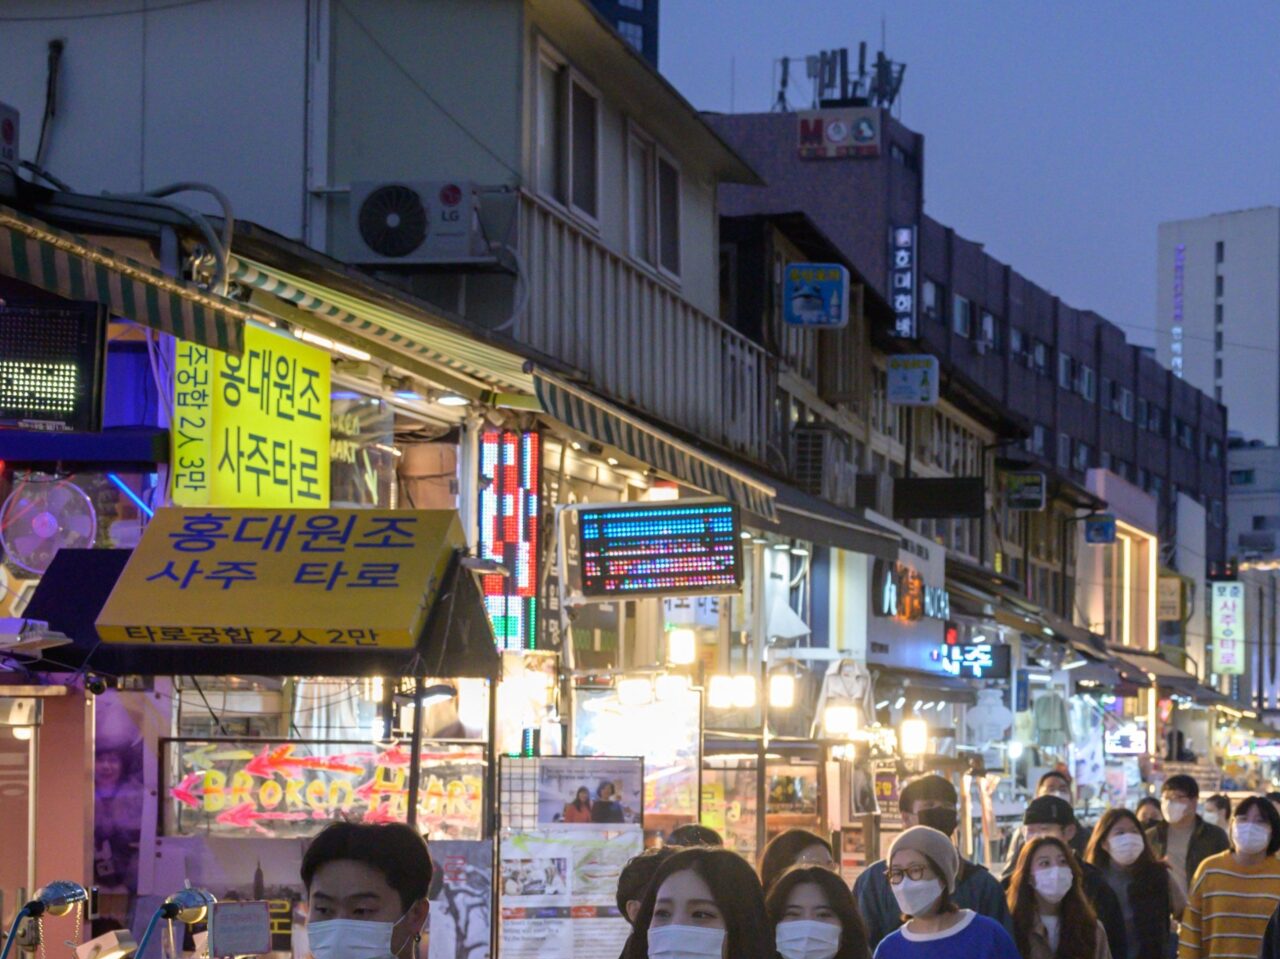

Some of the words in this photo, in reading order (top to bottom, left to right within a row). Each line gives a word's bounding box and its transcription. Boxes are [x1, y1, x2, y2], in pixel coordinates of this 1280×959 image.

[441, 211, 459, 222] LG
[217, 425, 322, 504] 사주타로
[168, 513, 418, 553] 홍대원조
[146, 559, 258, 590] 사주
[293, 560, 401, 591] 타로
[327, 629, 379, 647] 2만
[368, 765, 482, 822] HART
